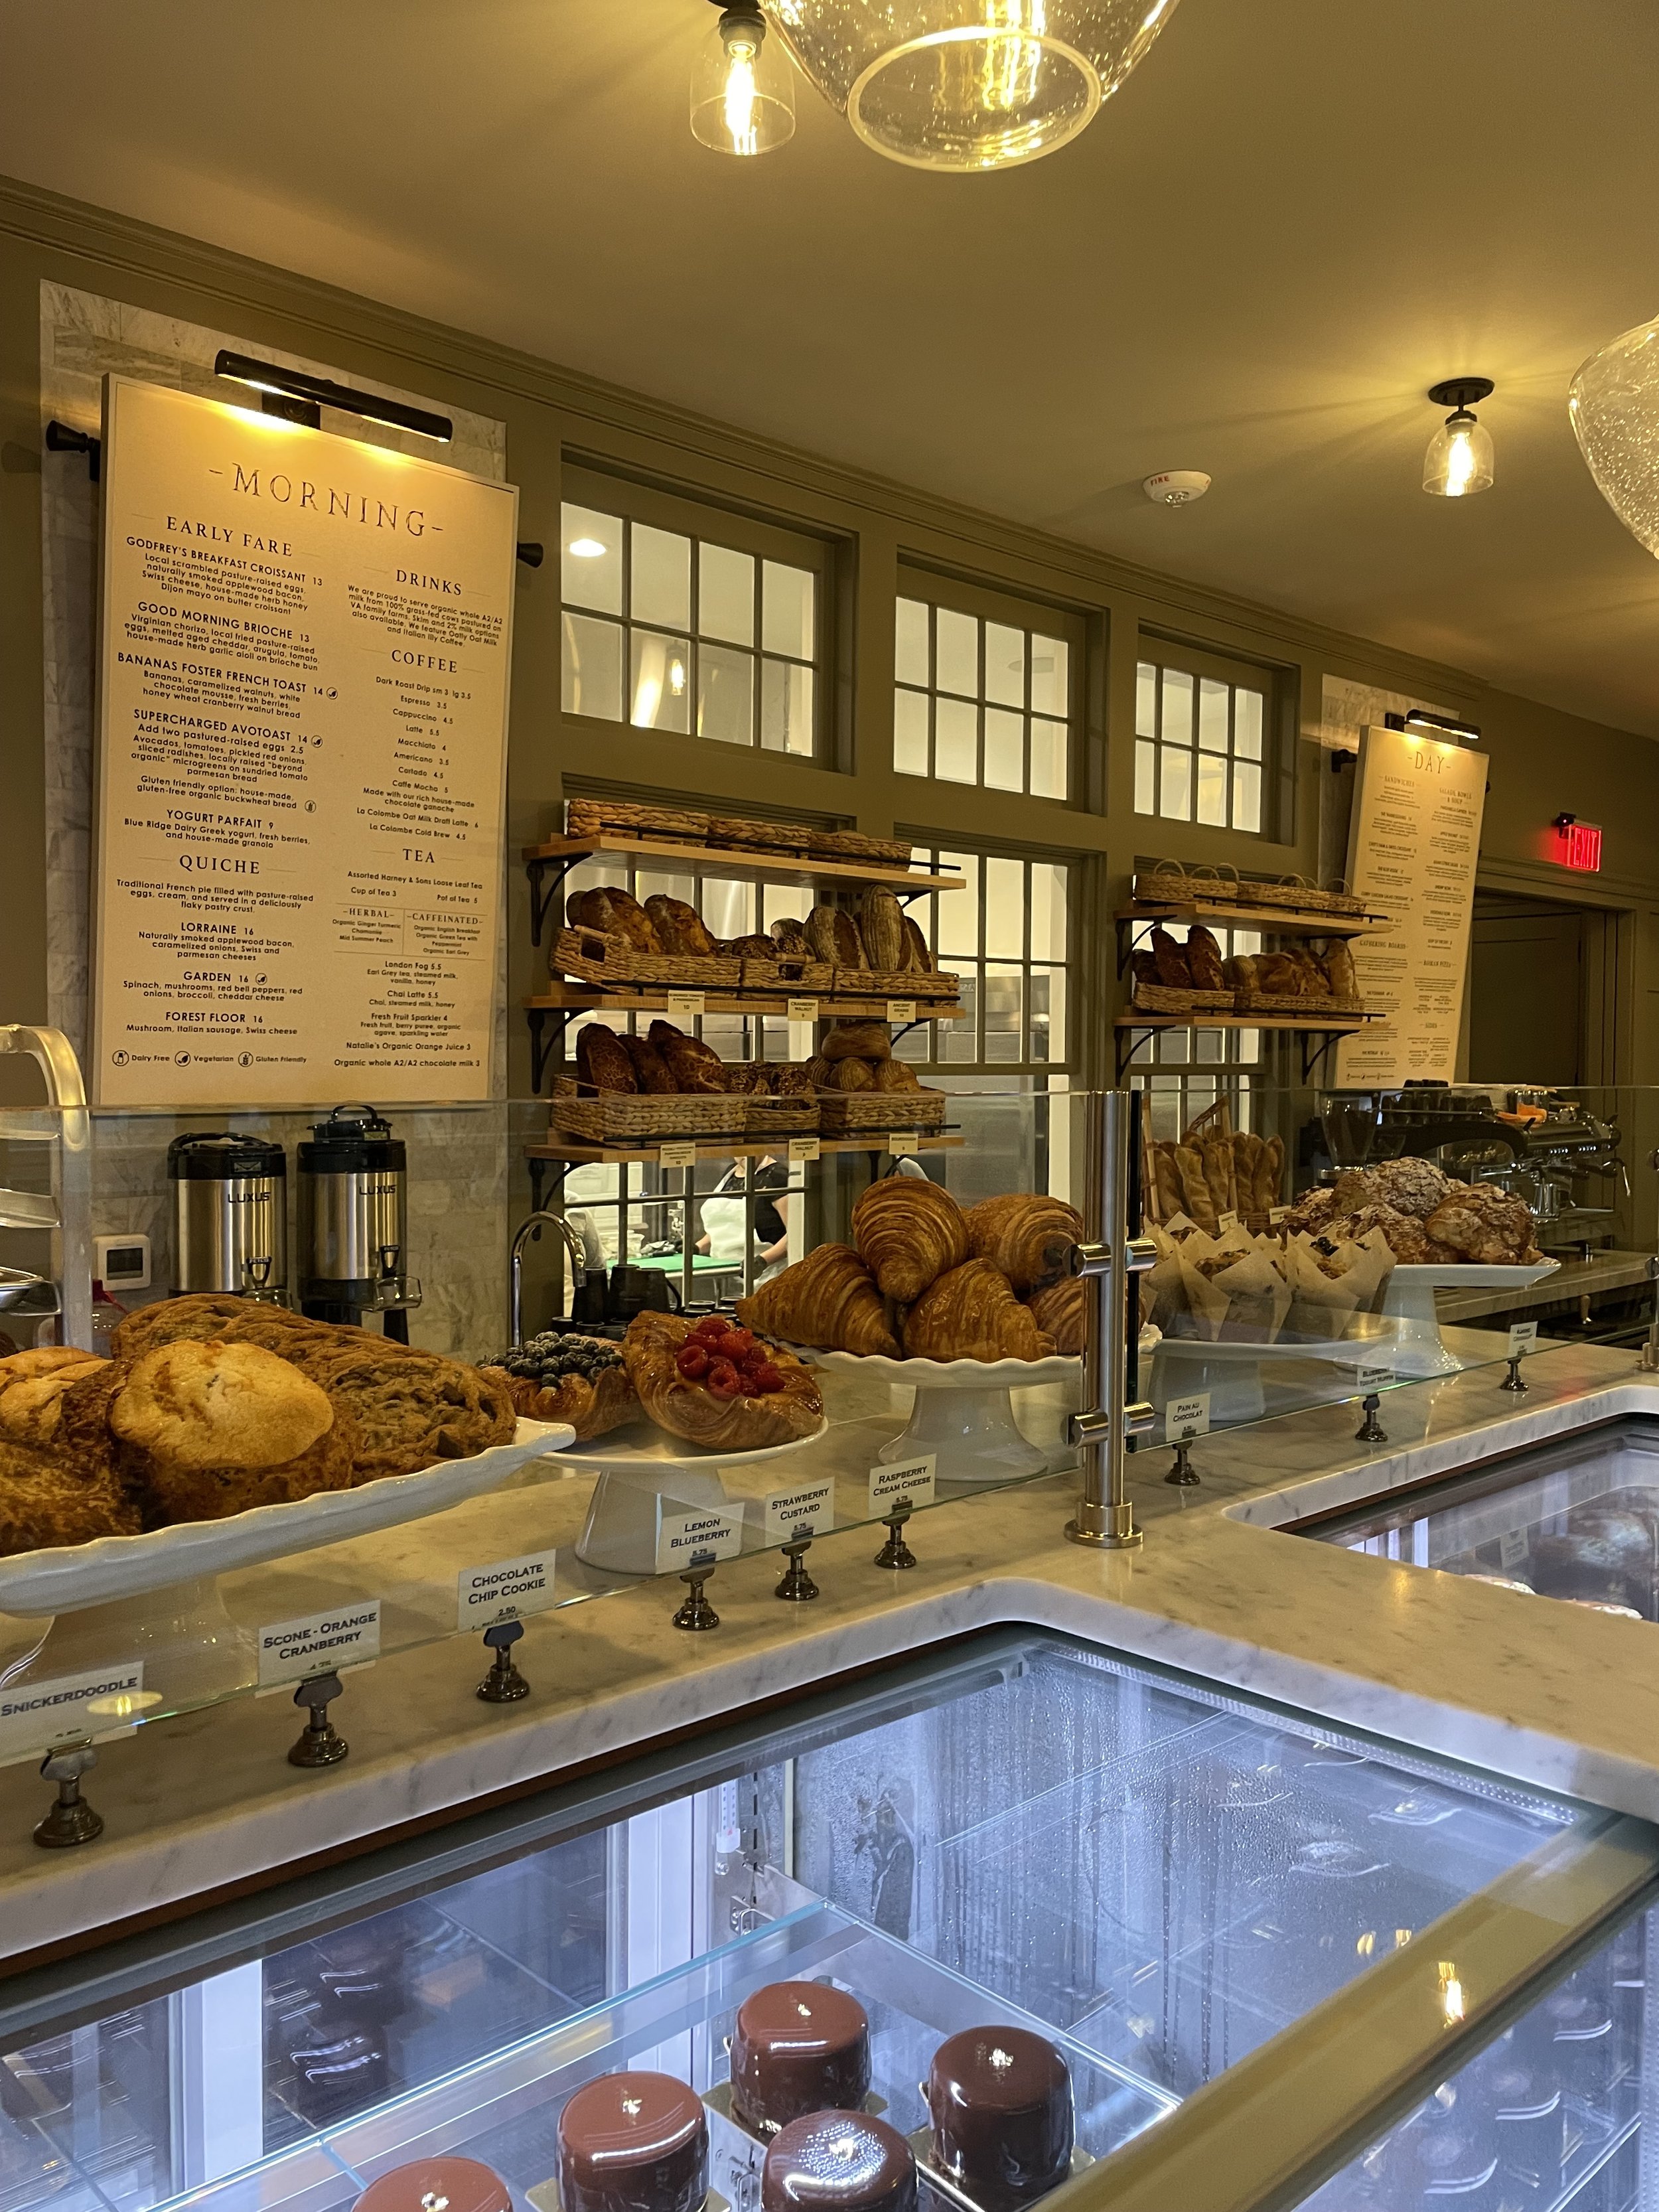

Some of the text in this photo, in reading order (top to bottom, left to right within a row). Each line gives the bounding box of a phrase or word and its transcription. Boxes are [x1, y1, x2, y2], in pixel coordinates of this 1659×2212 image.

[1150, 475, 1170, 486] FIRE
[166, 515, 292, 557] EARLY FARE
[126, 536, 322, 586] GODFREY'S BREAKFAST CROISSANT 13
[145, 552, 306, 594] Local scrambled pasture-raised eggs,
[146, 563, 304, 602] naturally smoked applewood bacon,
[396, 569, 461, 595] DRINKS
[141, 569, 308, 611] Swiss cheese, house-made herb honey
[161, 582, 183, 593] Dijon
[186, 589, 211, 599] mayo
[226, 595, 252, 607] butter
[253, 603, 291, 615] croissant
[137, 601, 309, 642] GOOD MORNING BRIOCHE 13
[391, 649, 457, 673] COFFEE
[117, 652, 323, 696] BANANAS FOSTER FRENCH TOAST 14
[376, 676, 393, 685] Dark
[395, 679, 415, 690] Roast
[415, 683, 431, 693] Drip
[452, 690, 459, 699] lg
[142, 686, 300, 719] honey wheat cranberry walnut bread
[400, 694, 447, 709] Espresso 3.5
[392, 707, 437, 722] Cappuccino
[133, 708, 307, 743] SUPERCHARGED AVOTOAST 14
[405, 724, 423, 733] Latte
[137, 723, 303, 754] Add two pastured-raised eggs 2.5
[397, 737, 436, 749] Macchiato
[393, 751, 449, 766] Americano 3.5
[1415, 751, 1445, 774] DAY
[397, 766, 427, 776] Cortado
[166, 808, 273, 830] YOGURT PARFAIT 9
[184, 832, 239, 845] house-made
[241, 840, 273, 848] granola
[1573, 828, 1597, 868] EXIT
[179, 854, 259, 874] QUICHE
[401, 848, 435, 863] TEA
[348, 907, 389, 918] HERBAL
[411, 912, 478, 924] CAFFEINATED
[180, 921, 253, 936] LORRAINE 16
[183, 970, 248, 983] GARDEN 16
[414, 962, 429, 971] Fog
[165, 1011, 263, 1023] FOREST FLOOR 16
[125, 1023, 175, 1033] Mushroom,
[333, 1058, 366, 1067] Organic
[228, 1191, 271, 1204] LUXUS
[359, 1184, 397, 1195] LUXUS
[1173, 1410, 1203, 1422] CHOCOLAT
[1177, 1404, 1191, 1414] PAIN
[878, 1465, 928, 1485] RASPBERRY
[873, 1476, 932, 1496] CREAM CHEESE
[772, 1487, 830, 1510] STRAWBERRY
[780, 1503, 820, 1520] CUSTARD
[684, 1518, 721, 1532] LEMON
[670, 1528, 731, 1548] BLUEBERRY
[472, 1563, 543, 1588] CHOCOLATE
[469, 1578, 546, 1605] CHIP COOKIE
[498, 1606, 516, 1617] 2.50
[263, 1629, 311, 1649] SCONE
[320, 1612, 377, 1634] ORANGE
[279, 1631, 362, 1660] CRANBERRY
[1, 1676, 138, 1717] SNICKERDOODLE
